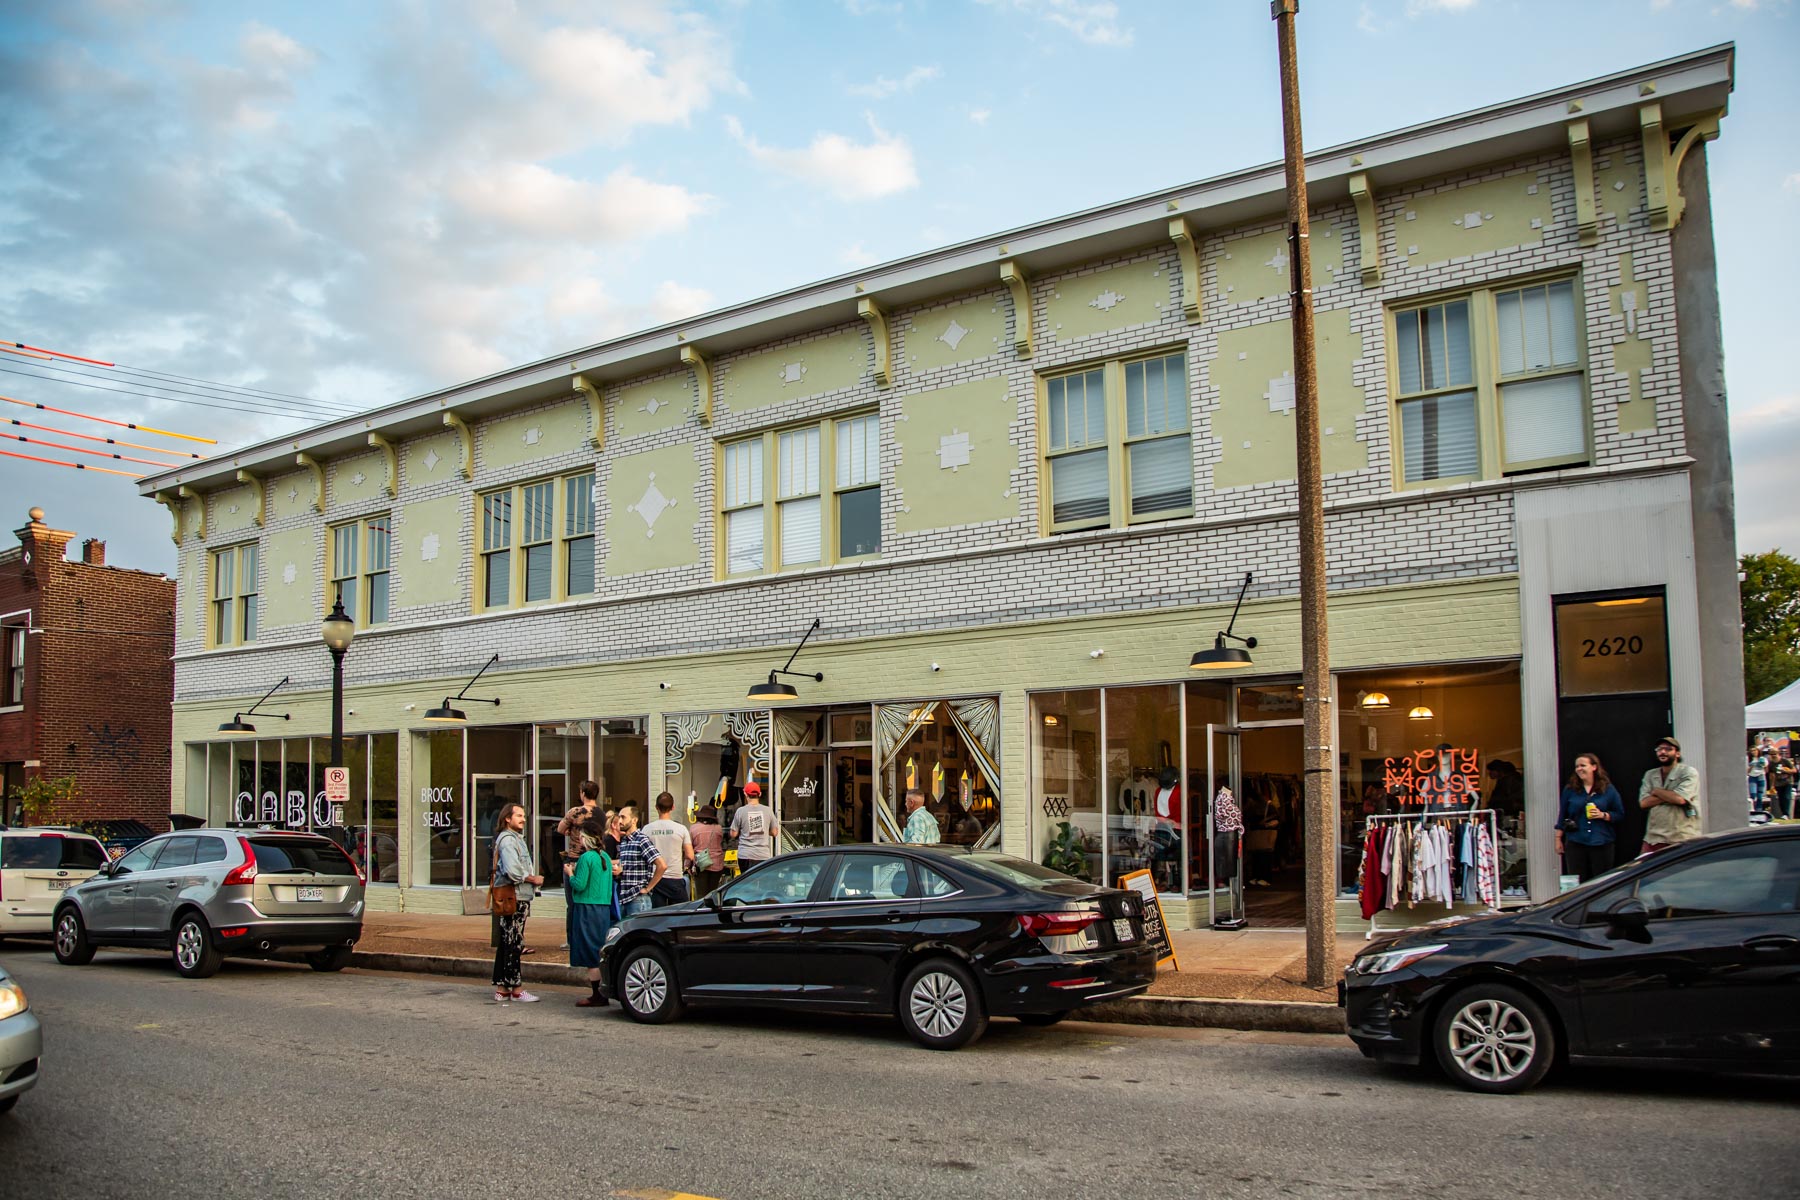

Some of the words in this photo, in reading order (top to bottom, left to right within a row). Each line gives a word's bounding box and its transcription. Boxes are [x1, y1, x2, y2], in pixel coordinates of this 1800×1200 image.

[1582, 635, 1643, 657] 2620
[1413, 748, 1479, 773] CITY
[1383, 767, 1480, 793] MOUSE
[421, 787, 453, 802] BROCK
[1397, 794, 1469, 805] VINTAGE
[235, 790, 332, 827] CABO
[422, 811, 451, 827] SEALS
[1144, 919, 1162, 933] OUSE
